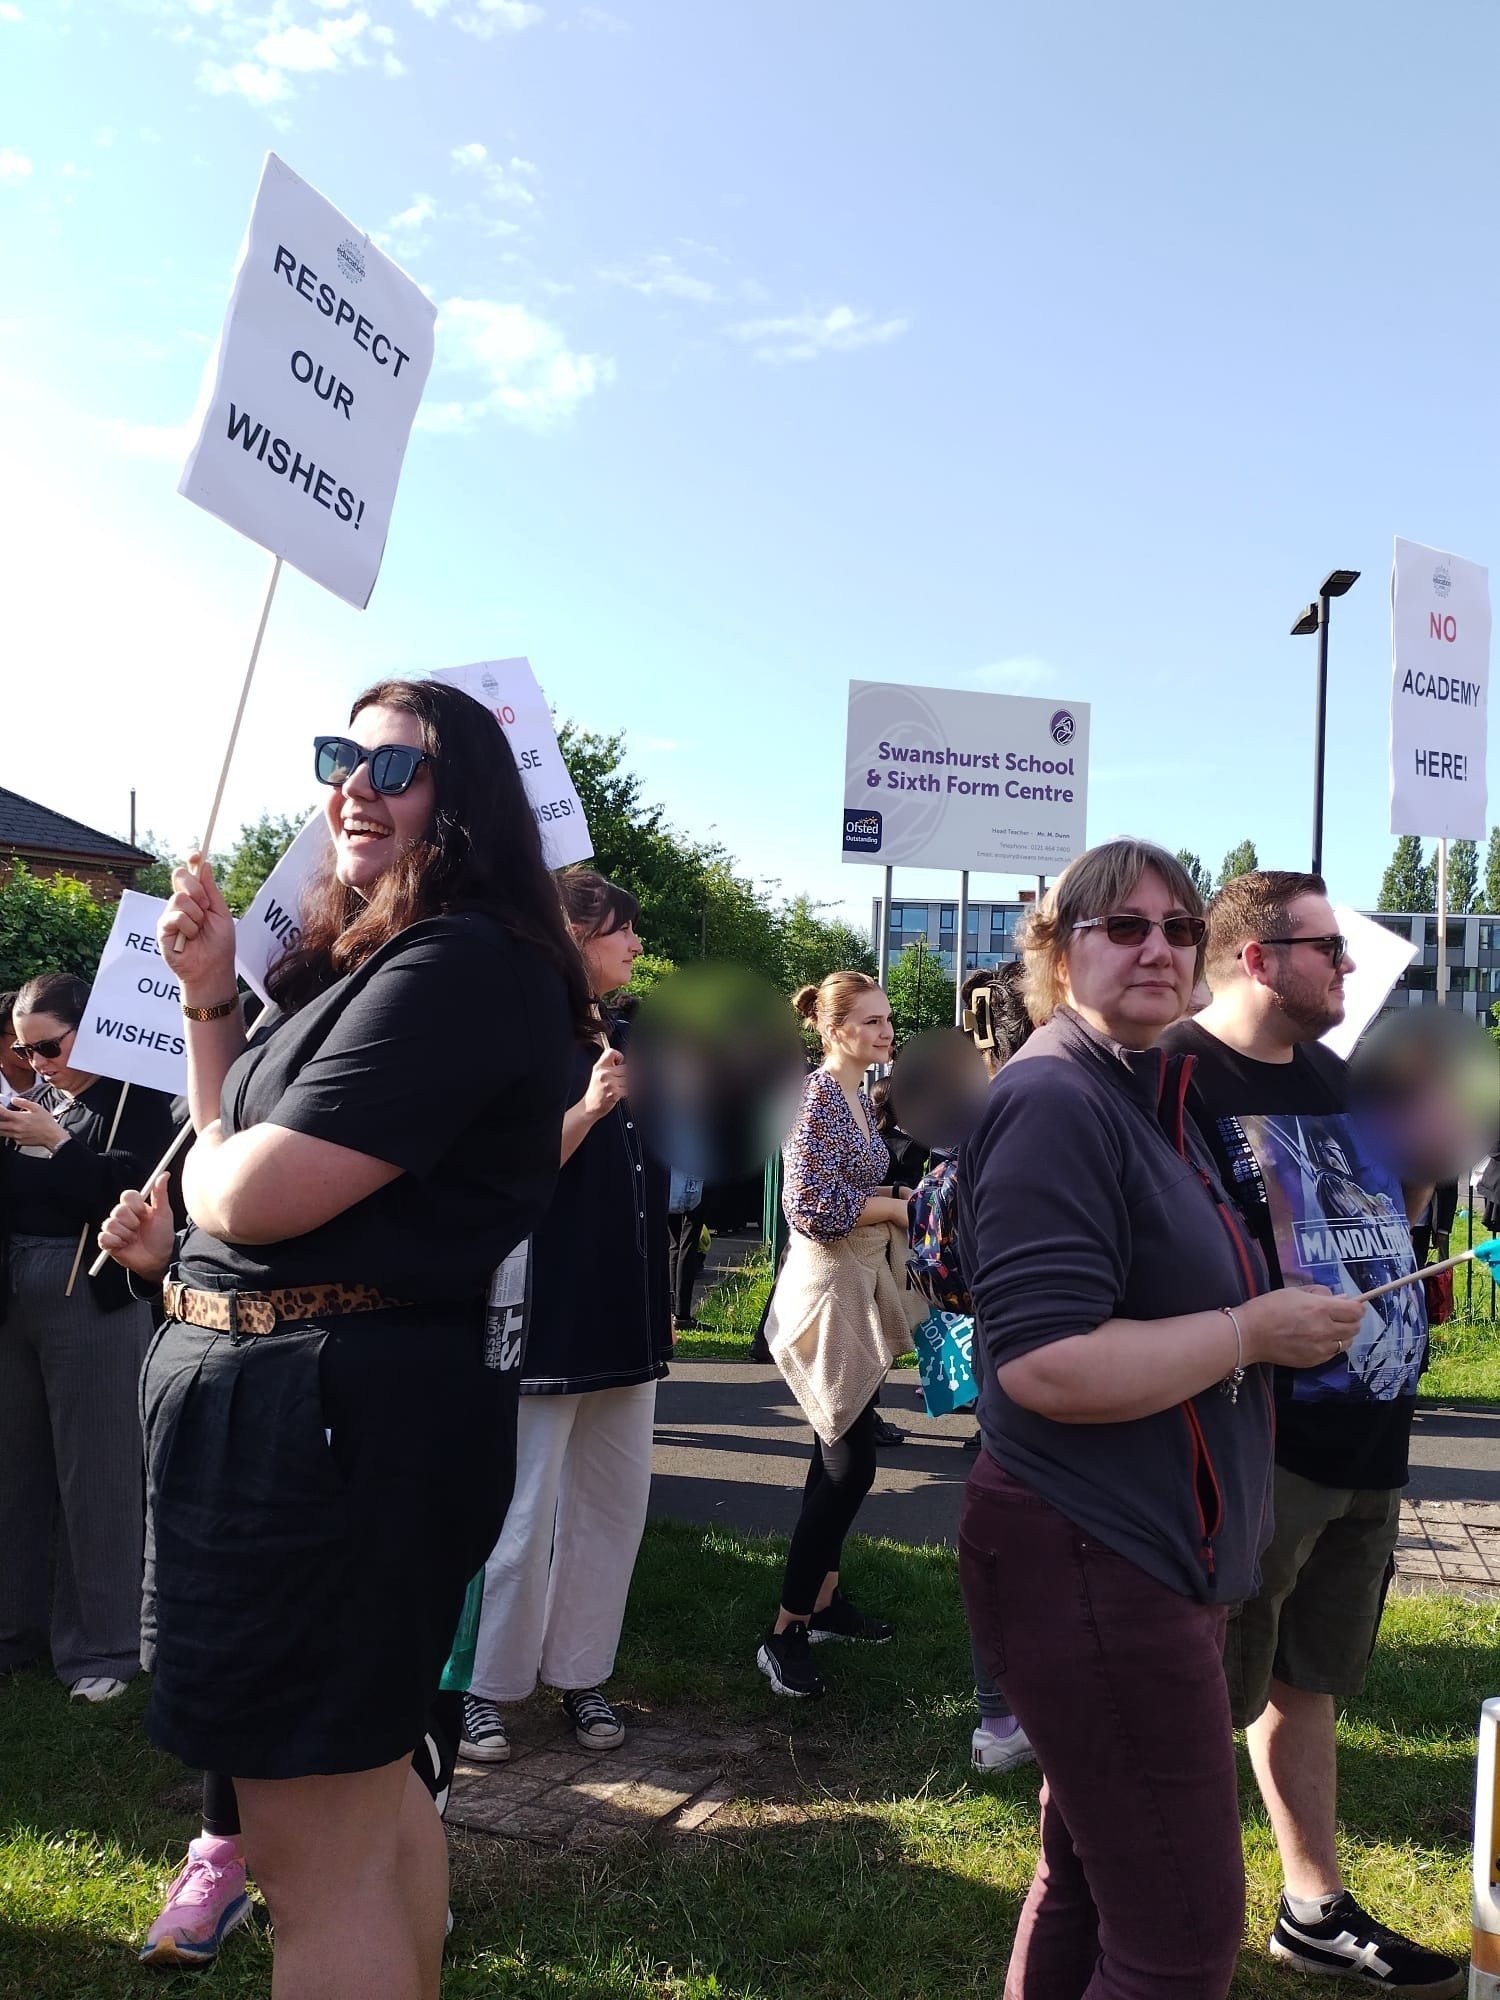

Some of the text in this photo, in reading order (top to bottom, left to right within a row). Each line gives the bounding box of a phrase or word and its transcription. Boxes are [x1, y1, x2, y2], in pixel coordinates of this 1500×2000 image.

[272, 244, 410, 379] RESPECT
[290, 349, 355, 420] OUR
[226, 402, 365, 531] WISHES!
[1429, 611, 1457, 643] NO
[1401, 668, 1481, 708] ACADEMY
[490, 706, 515, 726] NO
[878, 741, 1075, 776] Swanshurst School
[1415, 748, 1468, 782] HERE!
[866, 768, 1074, 803] & Sixth Form Centre
[532, 798, 576, 825] ISES!
[846, 821, 879, 834] Ofsted
[845, 835, 878, 845] Outstanding
[263, 898, 301, 951] WIS
[137, 978, 182, 1004] OUR
[95, 1017, 188, 1057] WISHES
[1230, 1116, 1245, 1139] THIS
[1241, 1142, 1252, 1154] IS
[1248, 1156, 1261, 1178] THE
[1256, 1181, 1268, 1203] WAY
